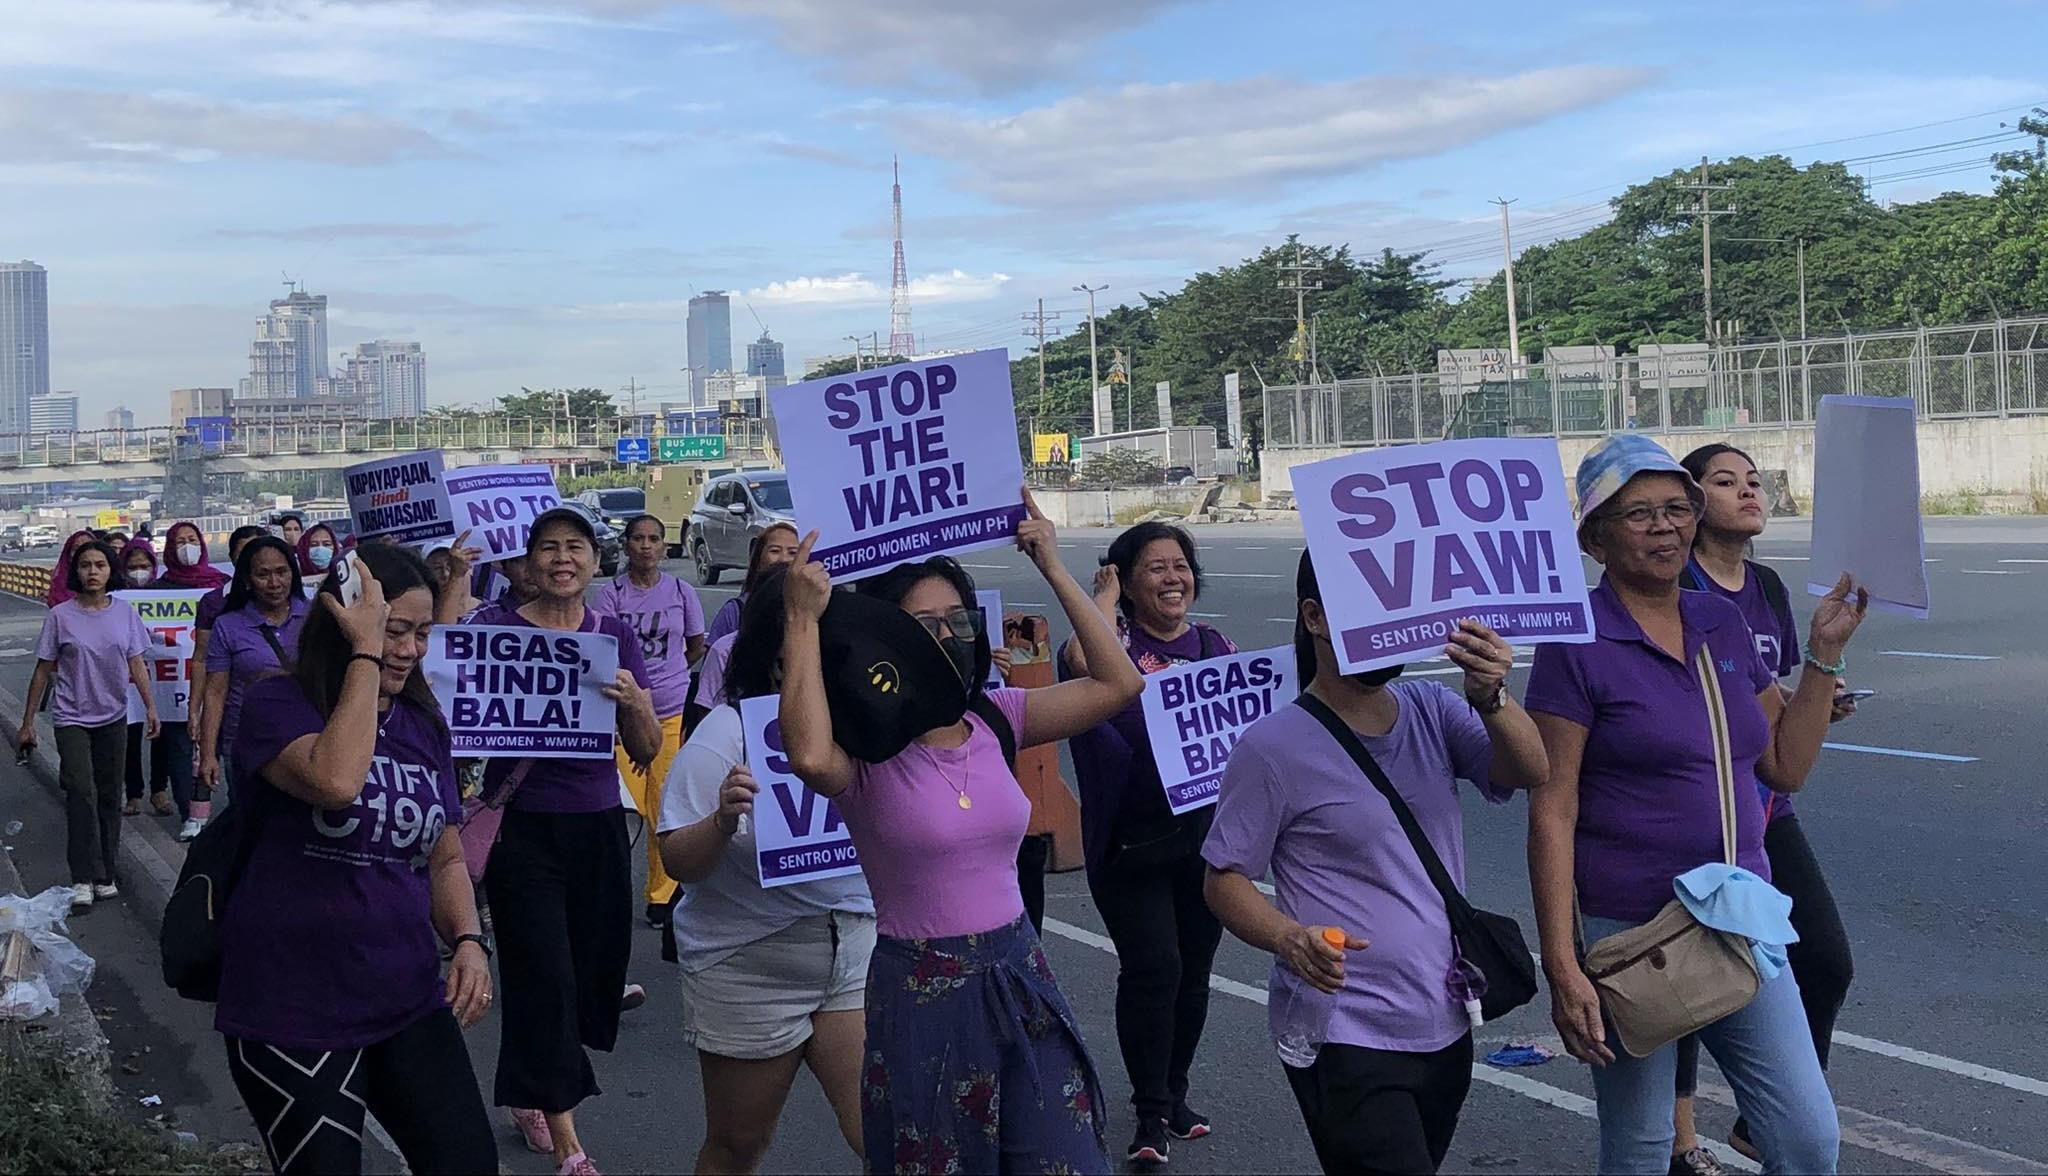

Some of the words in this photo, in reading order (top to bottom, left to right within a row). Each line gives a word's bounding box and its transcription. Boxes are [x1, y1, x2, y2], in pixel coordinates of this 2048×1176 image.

[824, 364, 957, 429] STOP
[680, 449, 704, 457] LANE
[848, 415, 949, 477] THE
[349, 461, 436, 496] KAPAYAPAAN,
[458, 478, 488, 489] SENTRO
[489, 476, 514, 486] WOMEN
[536, 474, 547, 484] PH
[370, 487, 409, 507] Hindi
[467, 497, 516, 526] NO
[842, 462, 968, 532] WAR!
[1330, 459, 1543, 540] STOP
[359, 498, 438, 532] KARAHASAN!
[435, 525, 447, 534] PH
[823, 546, 876, 572] SENTRO
[879, 531, 930, 555] WOMEN
[941, 520, 982, 542] WMW
[986, 515, 1008, 532] PH
[1349, 530, 1562, 611] VAW!
[1371, 621, 1446, 650] SENTRO
[1518, 612, 1554, 628] WMW
[1555, 612, 1572, 627] PH
[445, 630, 591, 674] BIGAS,
[456, 664, 579, 697] HINDI
[1159, 657, 1283, 710] BIGAS,
[451, 697, 582, 729] BALA!
[1175, 688, 1272, 742] HINDI
[451, 735, 483, 747] NTRO
[486, 736, 534, 747] WOMEN
[544, 737, 578, 748] WMW
[581, 737, 598, 748] PH
[1181, 779, 1220, 800] SENTRO
[779, 848, 831, 870] SENTRO
